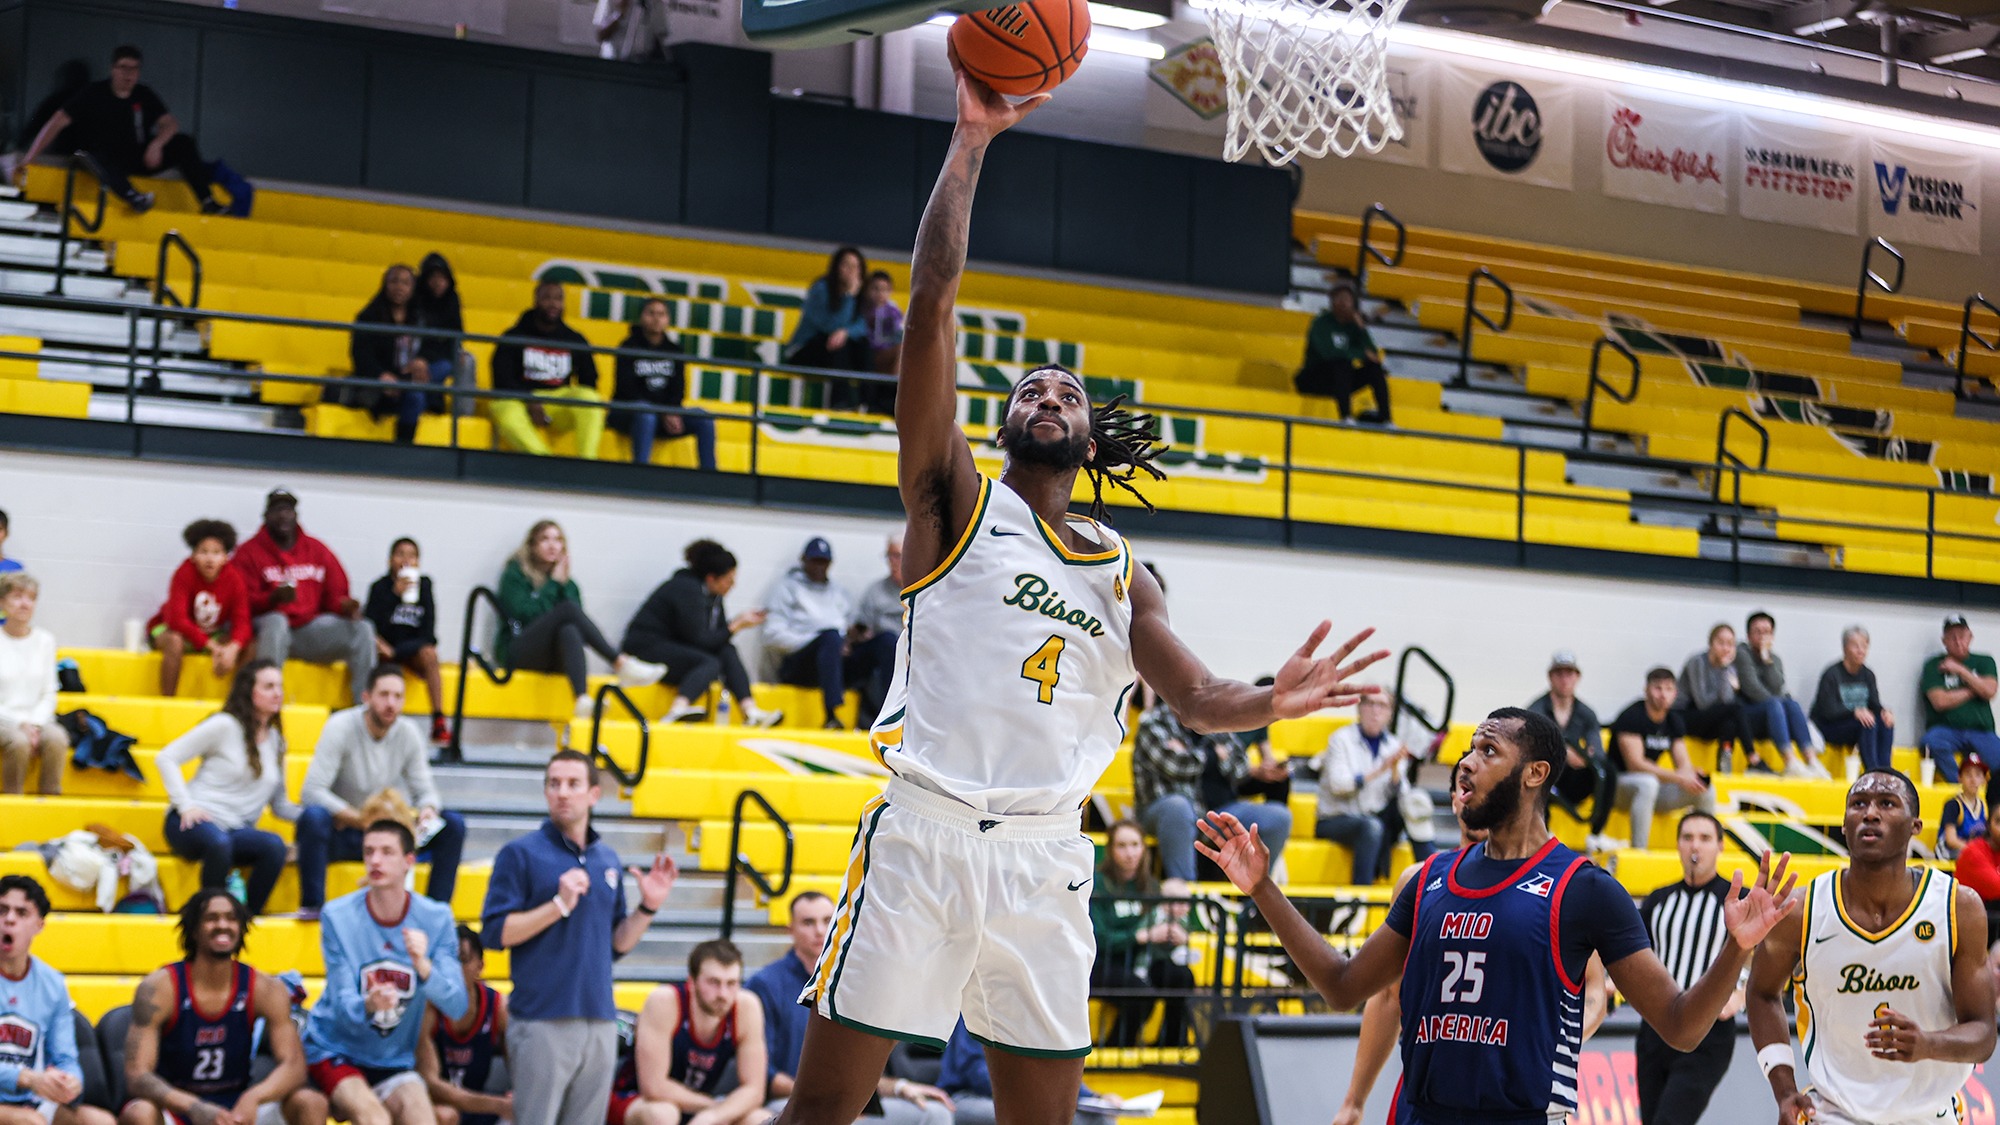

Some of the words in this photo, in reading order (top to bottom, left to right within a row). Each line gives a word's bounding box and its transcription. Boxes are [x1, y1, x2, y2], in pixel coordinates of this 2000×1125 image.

[1479, 84, 1538, 147] ibc
[1907, 174, 1964, 201] VISION
[1908, 193, 1964, 220] BANK
[1003, 573, 1105, 638] Bison
[1020, 633, 1066, 706] 4
[1439, 912, 1494, 940] MID
[1918, 923, 1933, 938] AE
[1440, 951, 1487, 1004] 25
[1837, 963, 1920, 995] Bison
[192, 1047, 226, 1081] 23
